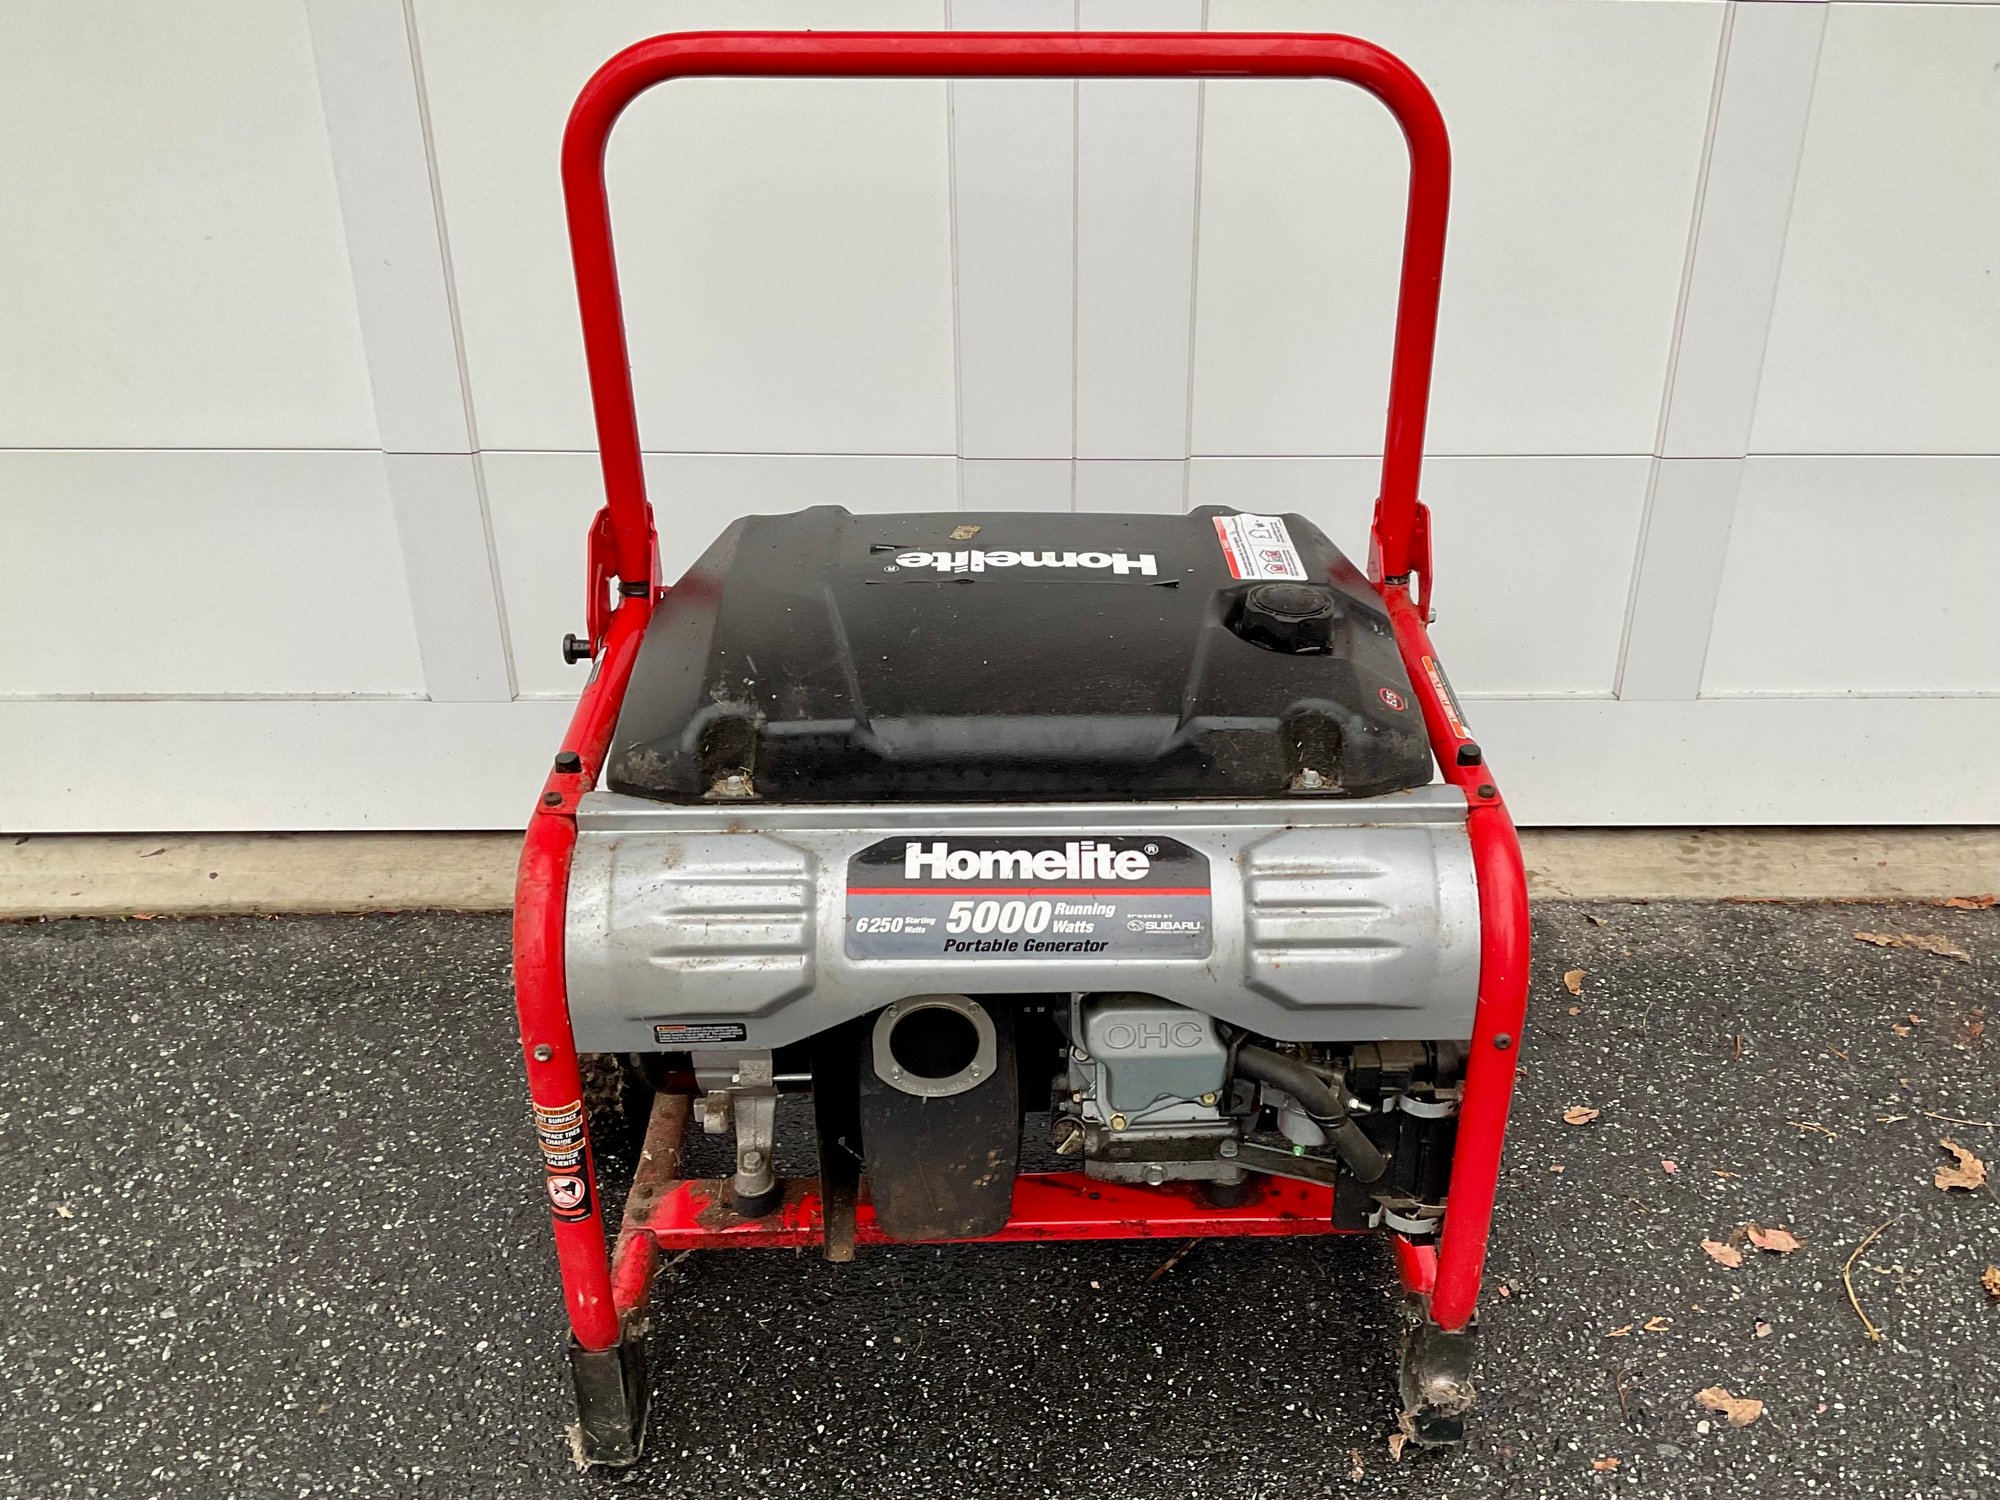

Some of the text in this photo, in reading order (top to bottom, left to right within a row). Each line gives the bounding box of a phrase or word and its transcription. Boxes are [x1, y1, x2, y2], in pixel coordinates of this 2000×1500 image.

[1054, 902, 1116, 917] Running
[904, 916, 936, 926] Starting
[946, 900, 1052, 934] 5000
[856, 917, 904, 933] 6250
[904, 926, 927, 934] Watts
[1052, 919, 1095, 934] Watts
[1145, 921, 1201, 930] SUBARU
[944, 938, 1109, 952] Portable Generator
[1103, 1022, 1202, 1049] OHC
[548, 1112, 577, 1124] SURFACE
[546, 1158, 577, 1166] CALIENTE
